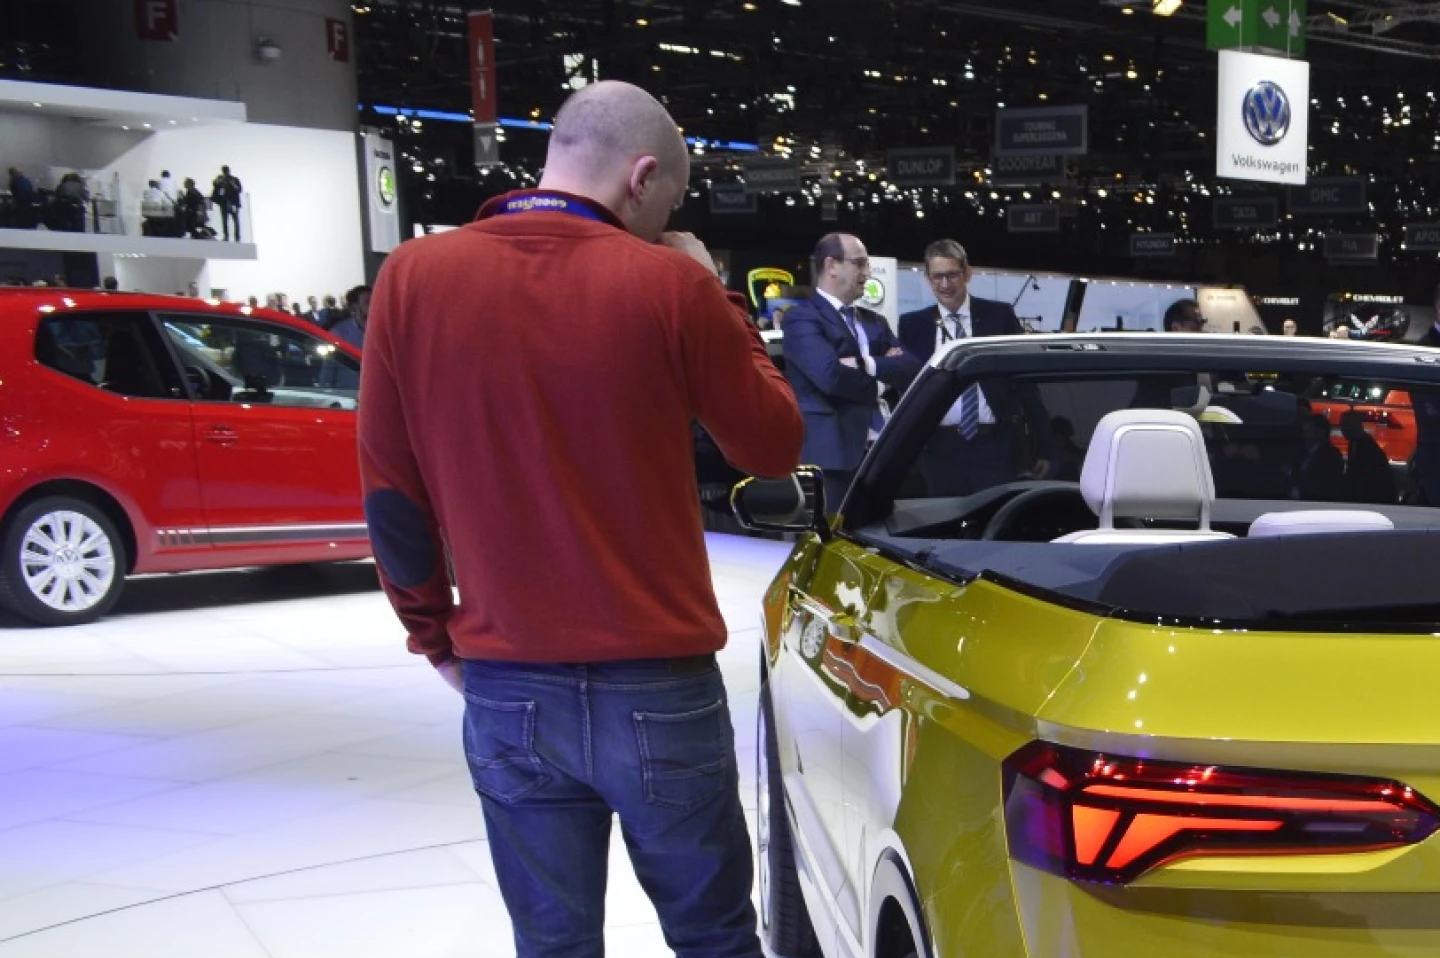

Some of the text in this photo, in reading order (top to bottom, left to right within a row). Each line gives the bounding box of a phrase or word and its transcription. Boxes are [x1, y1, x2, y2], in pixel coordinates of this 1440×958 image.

[146, 2, 168, 30] F
[334, 24, 346, 48] F
[898, 159, 943, 173] DUNLOP
[1232, 153, 1300, 175] Volkswagen
[1311, 188, 1339, 202] DMC
[1232, 206, 1257, 219] TATA
[1352, 294, 1404, 304] CHEVROLET
